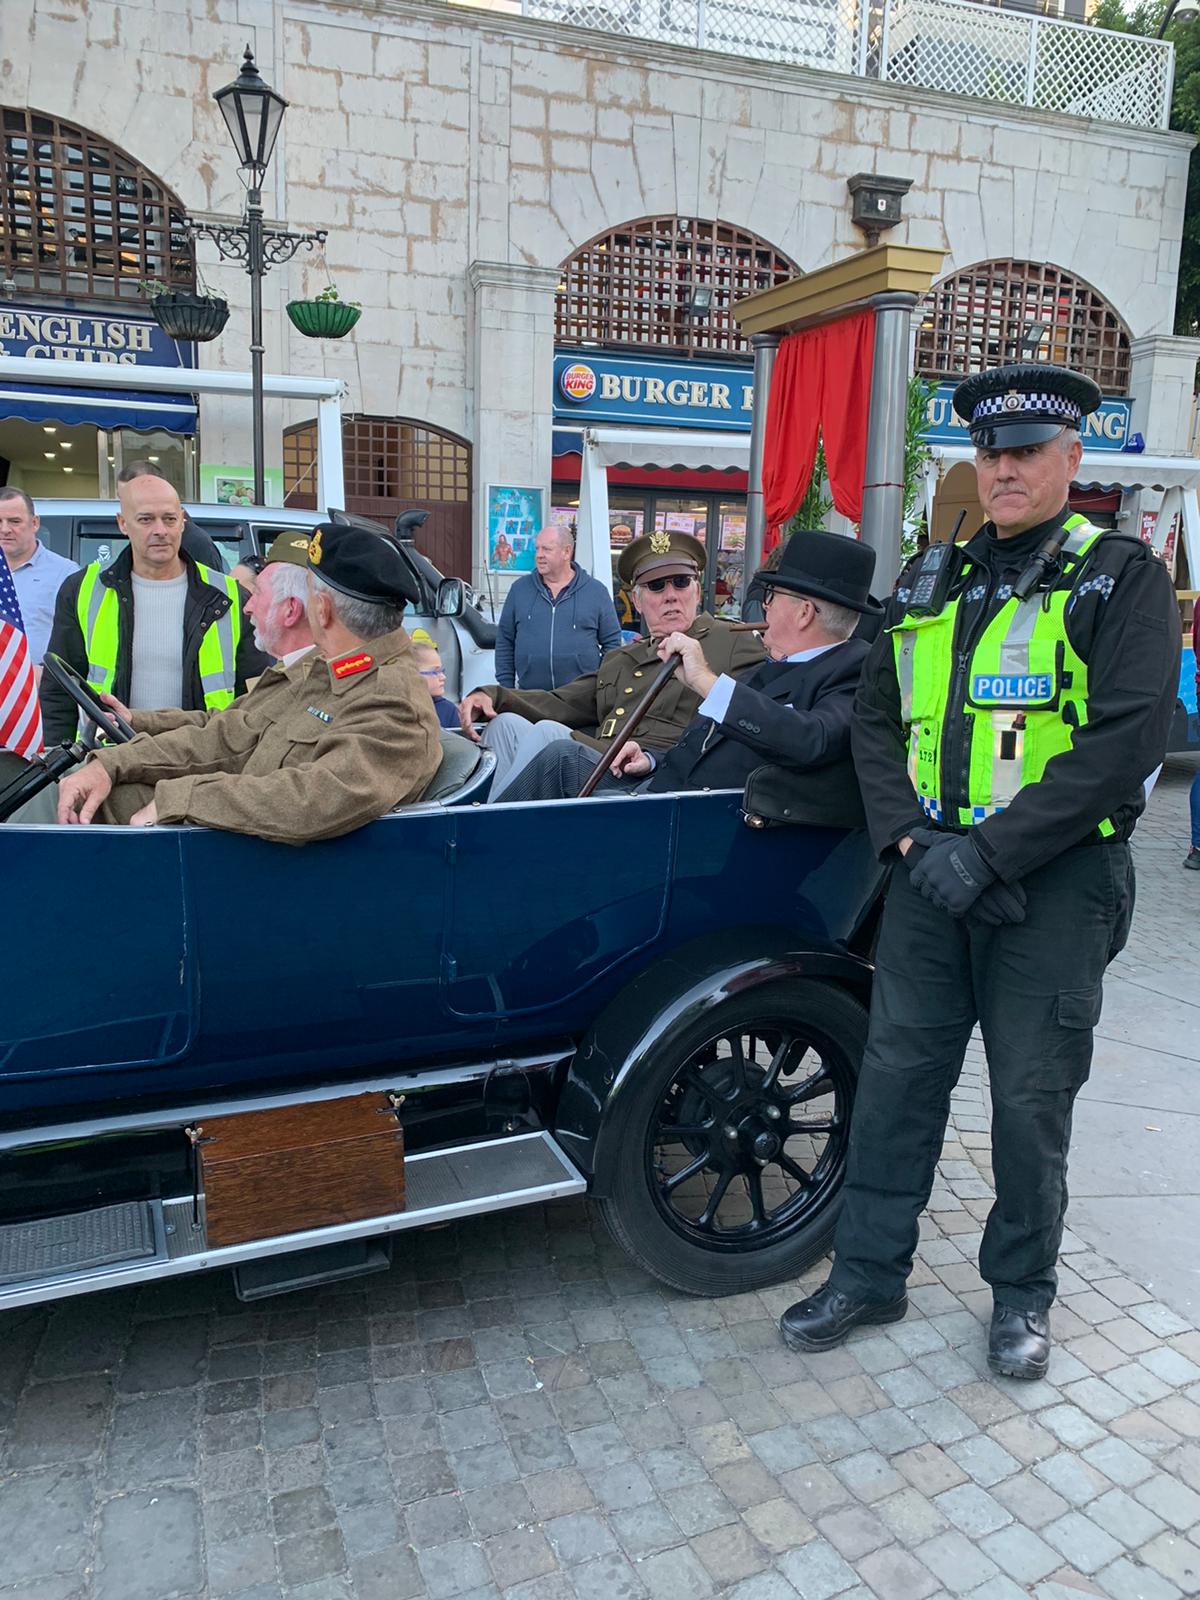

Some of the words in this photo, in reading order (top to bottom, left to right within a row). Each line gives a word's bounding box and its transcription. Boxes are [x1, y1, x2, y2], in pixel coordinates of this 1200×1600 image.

[0, 312, 153, 352] ENGLISH
[565, 380, 594, 391] KING
[566, 372, 594, 381] BURGER
[599, 373, 732, 410] BURGER
[1078, 411, 1126, 440] NG
[977, 677, 1047, 697] POLICE
[919, 750, 933, 763] 172
